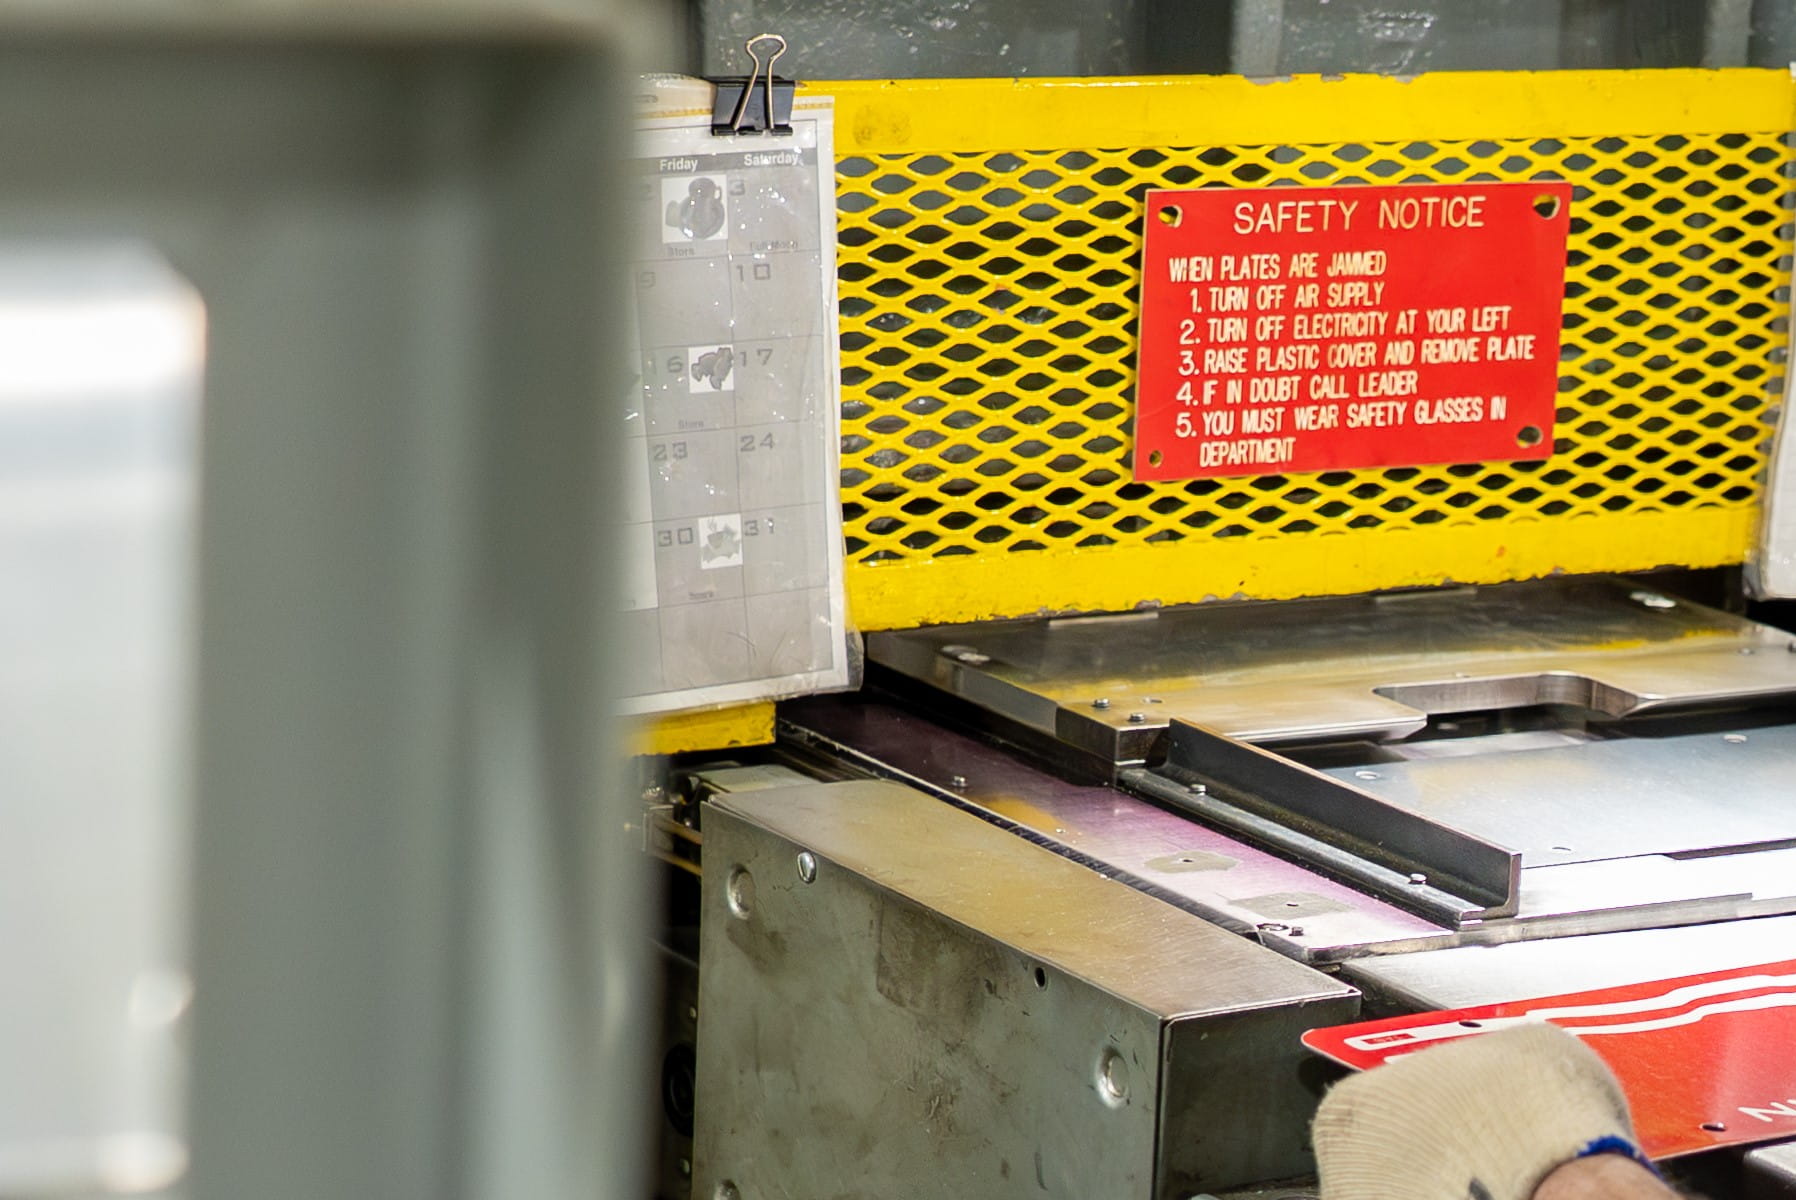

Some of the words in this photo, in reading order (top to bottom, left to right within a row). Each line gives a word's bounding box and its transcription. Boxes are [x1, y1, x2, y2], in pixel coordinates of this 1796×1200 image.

[660, 158, 698, 173] Friday
[744, 152, 799, 167] Saturday
[1234, 200, 1358, 234] SAFETY
[1379, 196, 1486, 229] NOTICE
[736, 263, 771, 282] 10
[1169, 256, 1213, 282] WHEN
[1221, 254, 1280, 281] PLATES
[1289, 253, 1318, 278] ARE
[1327, 251, 1387, 276] JAMMED
[1190, 287, 1202, 313] 1.
[1209, 286, 1248, 312] TURN
[1256, 284, 1286, 309] OFF
[1294, 284, 1319, 308] AIR
[1327, 282, 1384, 307] SUPPLY
[1180, 321, 1200, 344] 2.
[1208, 317, 1247, 343] TURN
[1256, 315, 1286, 341] OFF
[1294, 311, 1388, 339] ELECTRICITY
[1396, 310, 1417, 333] AT
[1427, 308, 1465, 332] YOUR
[1472, 306, 1511, 331] LEFT
[740, 348, 774, 367] 17
[1179, 352, 1200, 376] 3.
[1204, 348, 1247, 374] RAISE
[1257, 345, 1320, 372] PLASTIC
[1327, 343, 1376, 369] COVER
[1384, 341, 1414, 366] AND
[1422, 338, 1478, 364] REMOVE
[1486, 335, 1535, 360] PLATE
[1176, 383, 1198, 406] 4.
[1203, 379, 1218, 404] IF
[1227, 379, 1242, 403] IN
[1250, 375, 1301, 402] DOUBT
[1310, 373, 1349, 399] CALL
[1358, 371, 1417, 397] LEADER
[1176, 413, 1197, 438] 5.
[1202, 411, 1234, 436] YOU
[1242, 408, 1285, 433] MUST
[1294, 405, 1338, 431] WEAR
[1347, 402, 1406, 428] SAFETY
[1415, 399, 1483, 424] GLASSES
[1491, 396, 1506, 421] IN
[653, 441, 688, 462] 23
[740, 432, 775, 453] 24
[1200, 437, 1296, 468] DEPARTMENT
[657, 527, 694, 547] 30
